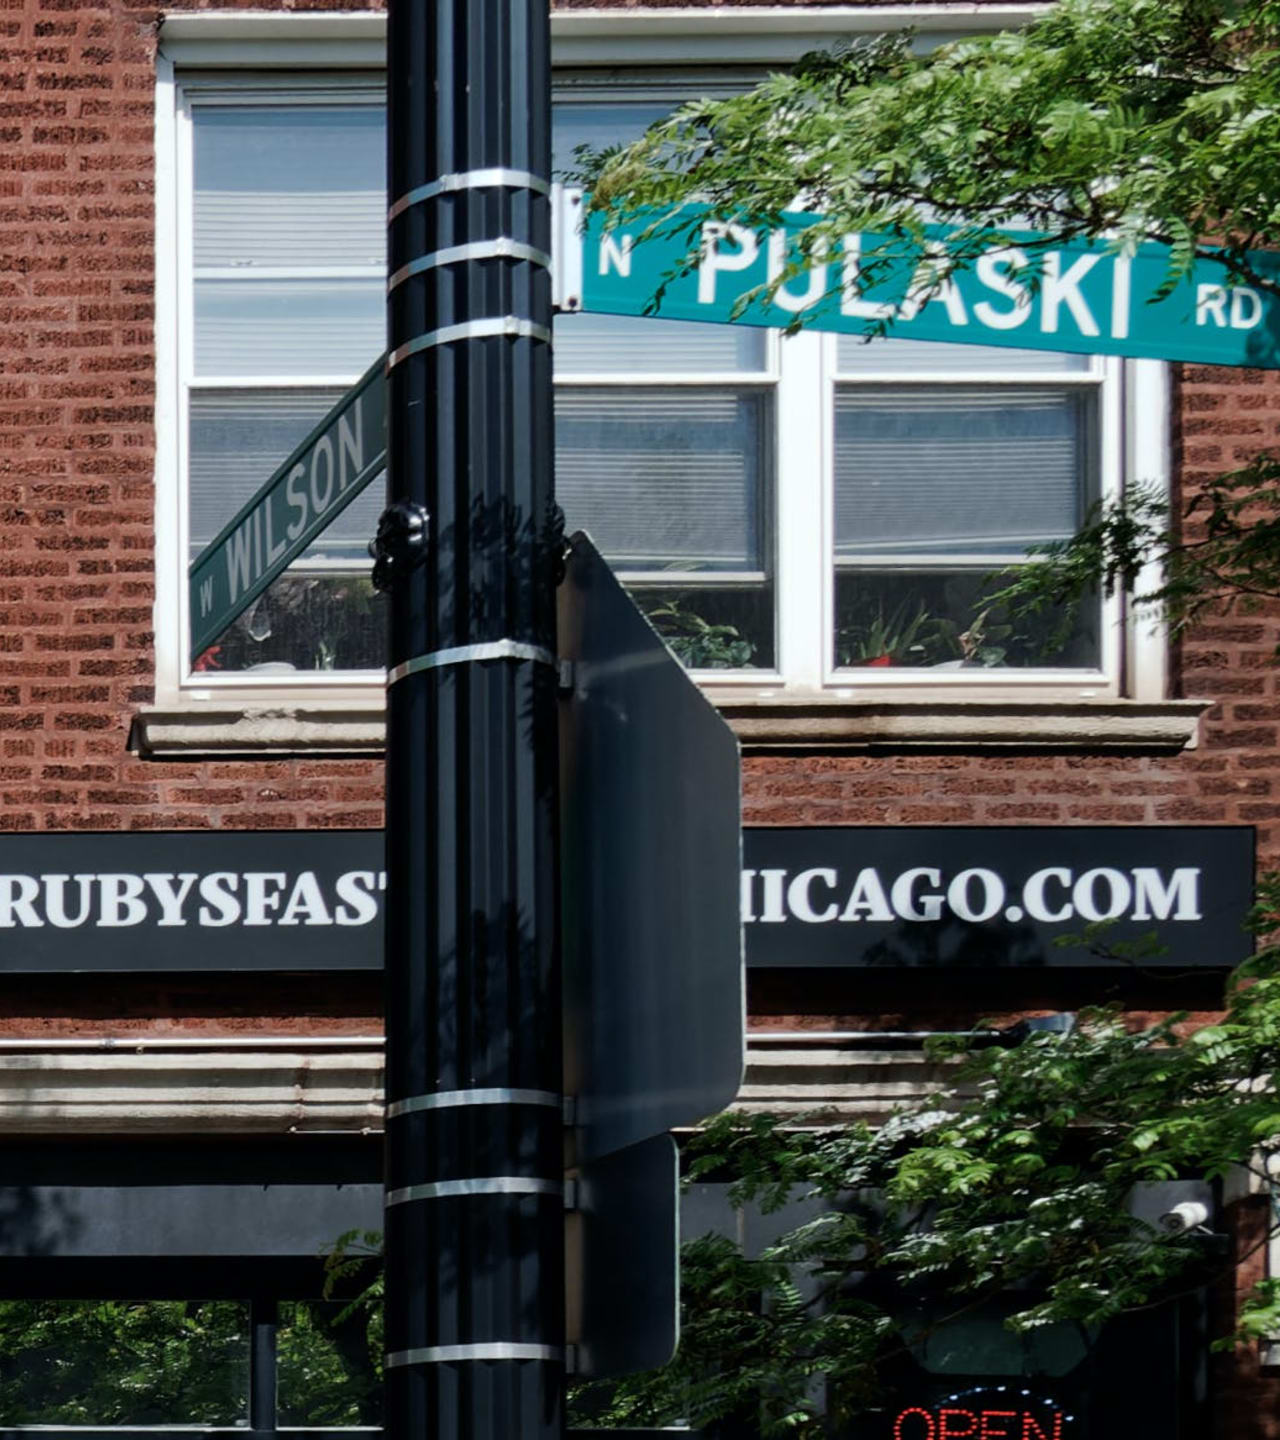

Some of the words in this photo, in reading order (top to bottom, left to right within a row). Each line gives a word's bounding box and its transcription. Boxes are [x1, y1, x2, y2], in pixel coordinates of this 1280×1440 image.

[598, 233, 632, 277] N
[697, 219, 1132, 338] PULASKI
[1196, 283, 1263, 329] RD
[200, 575, 214, 617] W
[226, 396, 364, 606] WILSON
